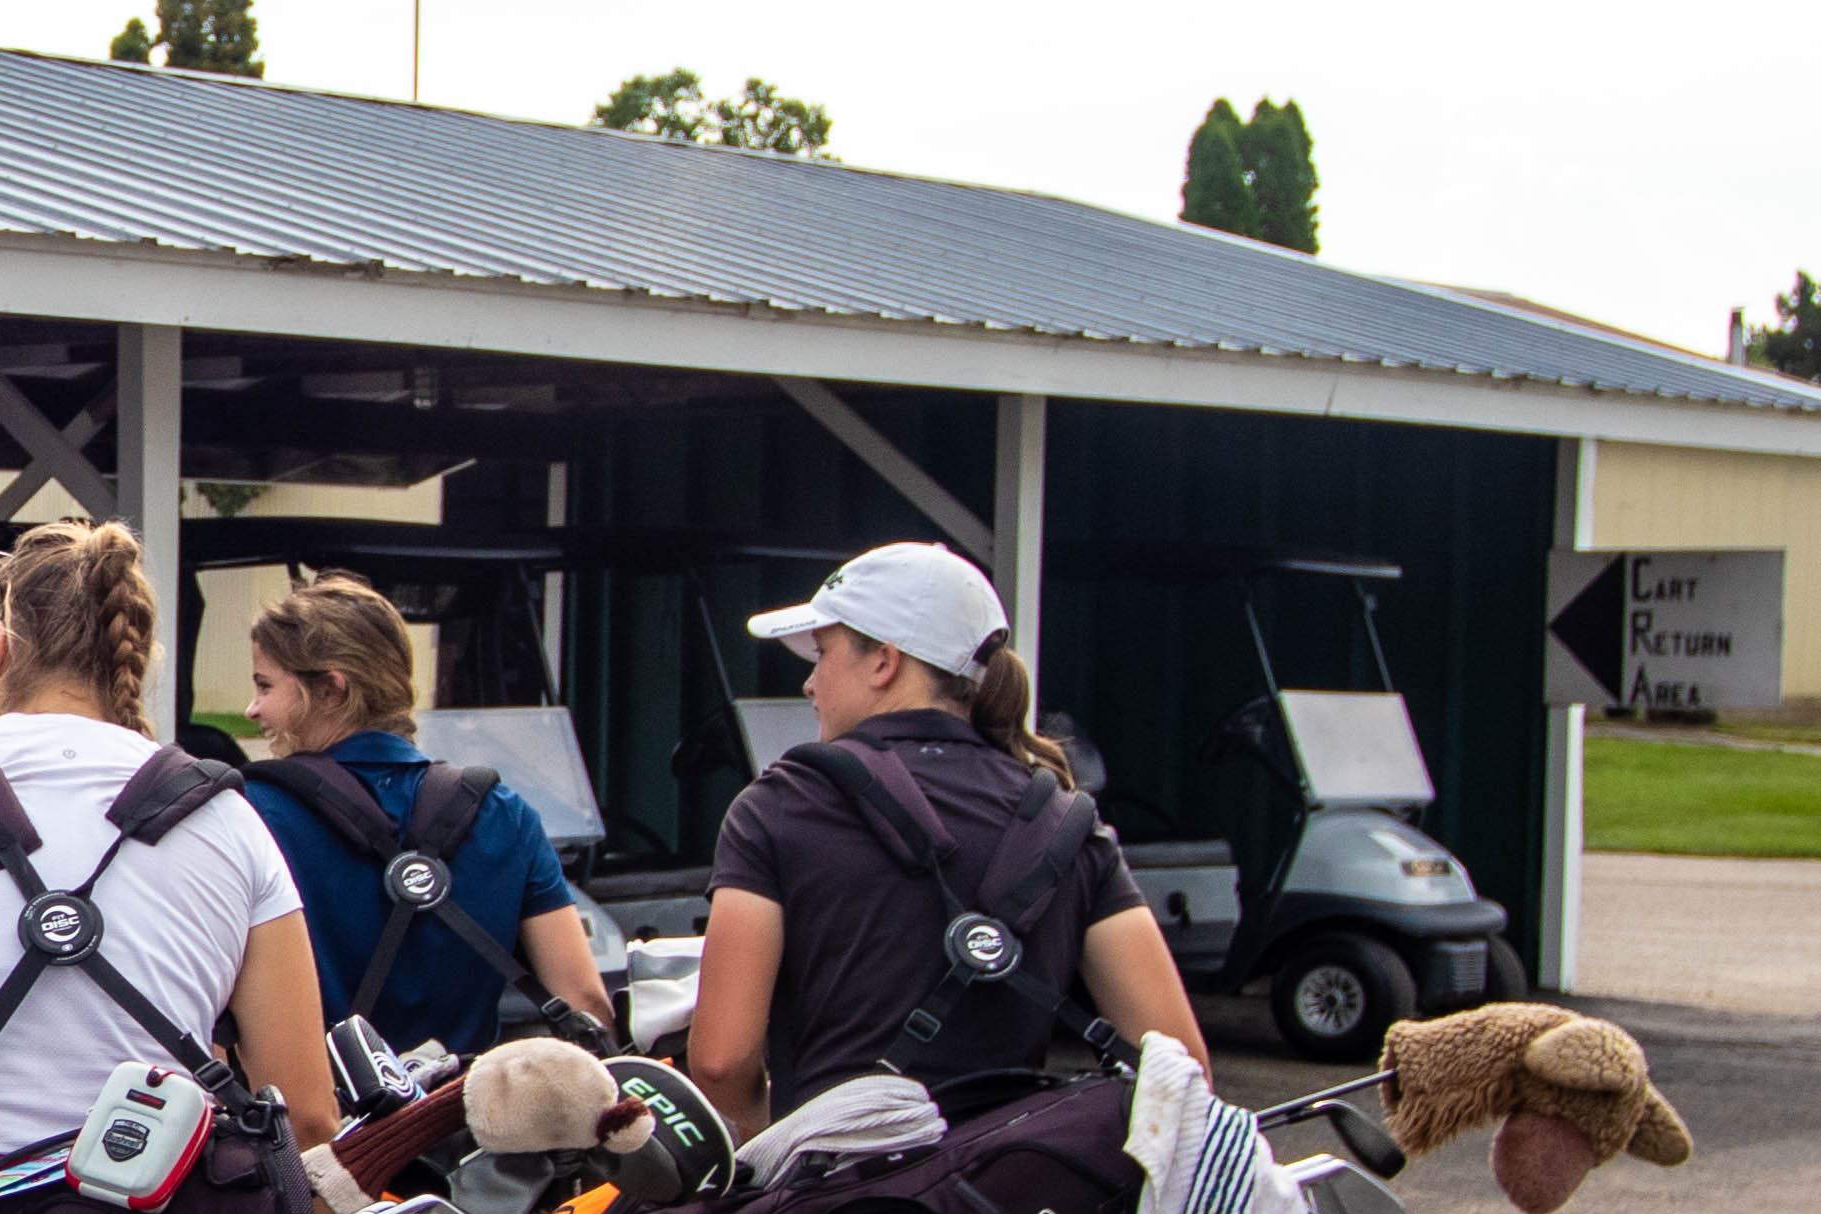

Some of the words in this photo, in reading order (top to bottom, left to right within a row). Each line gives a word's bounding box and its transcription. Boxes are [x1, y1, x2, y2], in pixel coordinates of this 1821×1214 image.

[1630, 611, 1732, 657] RETURN
[1628, 664, 1700, 706] AREA
[40, 915, 81, 933] DISC
[966, 937, 1003, 950] DISC
[620, 1076, 706, 1149] EPIC
